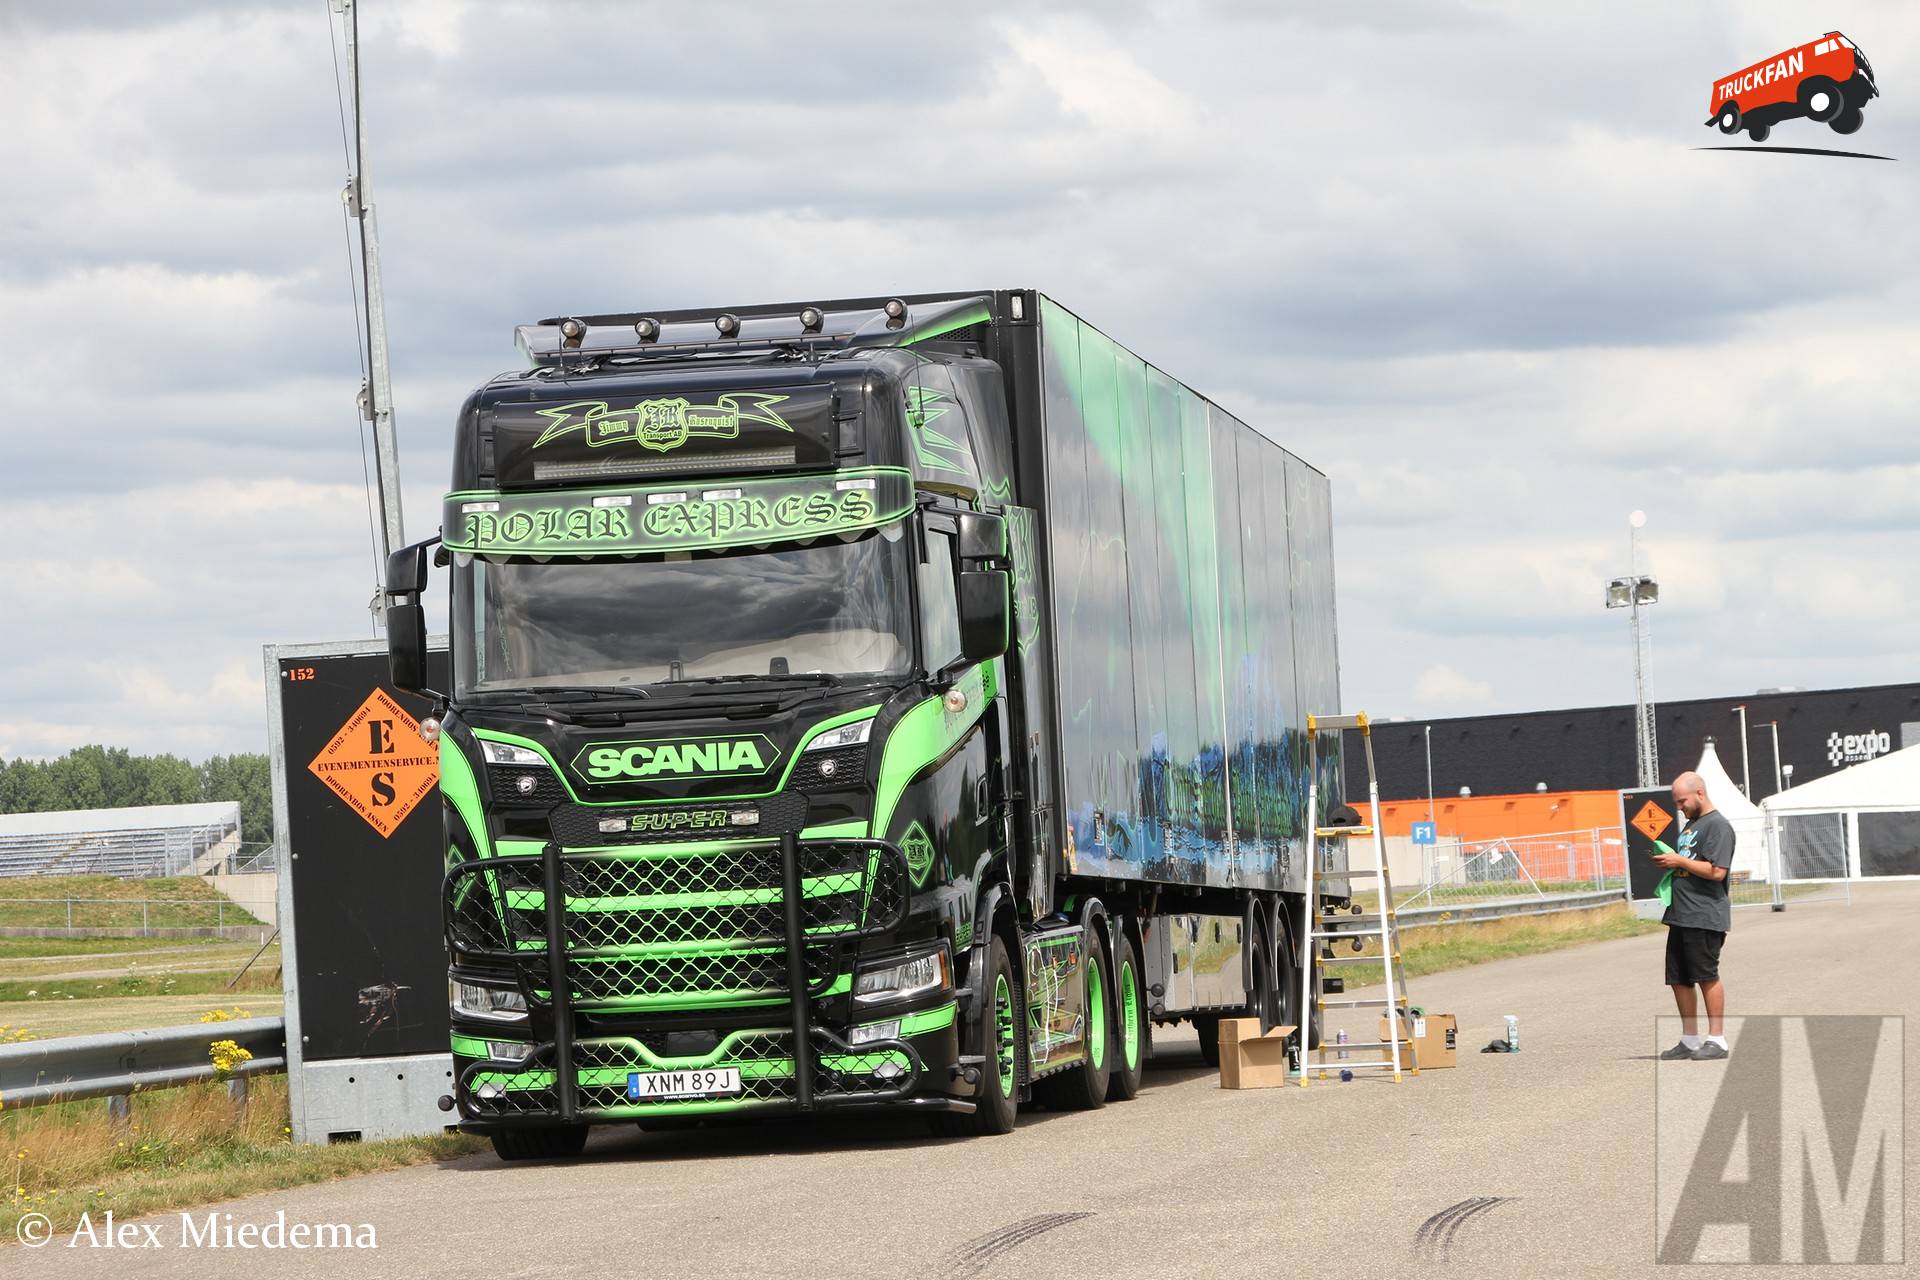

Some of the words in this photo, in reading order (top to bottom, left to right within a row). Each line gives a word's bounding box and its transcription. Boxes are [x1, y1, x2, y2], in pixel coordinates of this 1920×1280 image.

[643, 430, 672, 440] Transport
[464, 506, 630, 549] POLAR
[643, 490, 875, 540] EXPRESS
[289, 667, 315, 681] 152
[328, 736, 345, 756] 0592
[347, 706, 372, 733] 340694
[377, 694, 419, 732] DOORENBOS
[368, 719, 395, 755] E
[1843, 731, 1891, 759] expo
[587, 740, 766, 779] SCANIA
[326, 775, 366, 814] DOORENBOS
[366, 812, 389, 833] ASSEN
[371, 772, 396, 808] S
[393, 802, 411, 822] 0592
[412, 772, 437, 800] 340694
[631, 810, 728, 831] SUPER
[1415, 826, 1431, 840] F1
[646, 1073, 685, 1094] XNM
[692, 1071, 730, 1091] 89J
